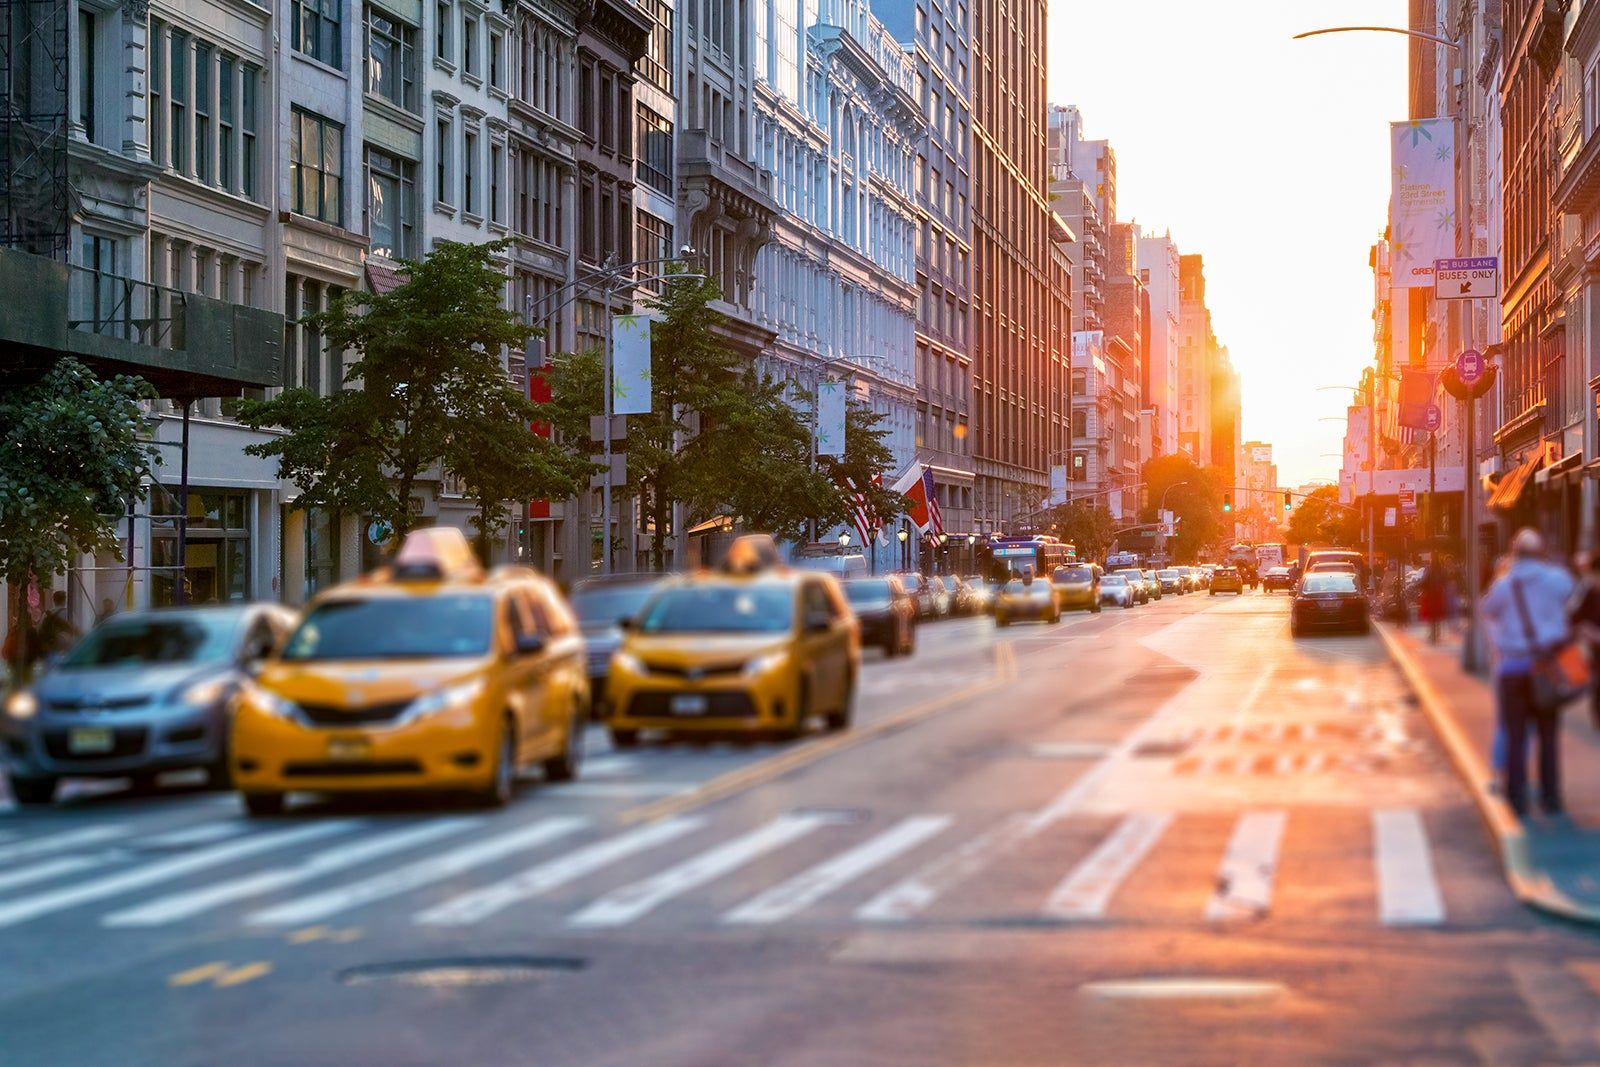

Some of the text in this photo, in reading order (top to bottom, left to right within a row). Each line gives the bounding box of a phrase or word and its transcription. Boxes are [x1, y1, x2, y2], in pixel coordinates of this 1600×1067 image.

[1400, 190, 1446, 199] 23rd Street
[1451, 260, 1468, 268] BUS
[1411, 267, 1434, 276] GREY
[1439, 270, 1494, 280] BUSES ONLY
